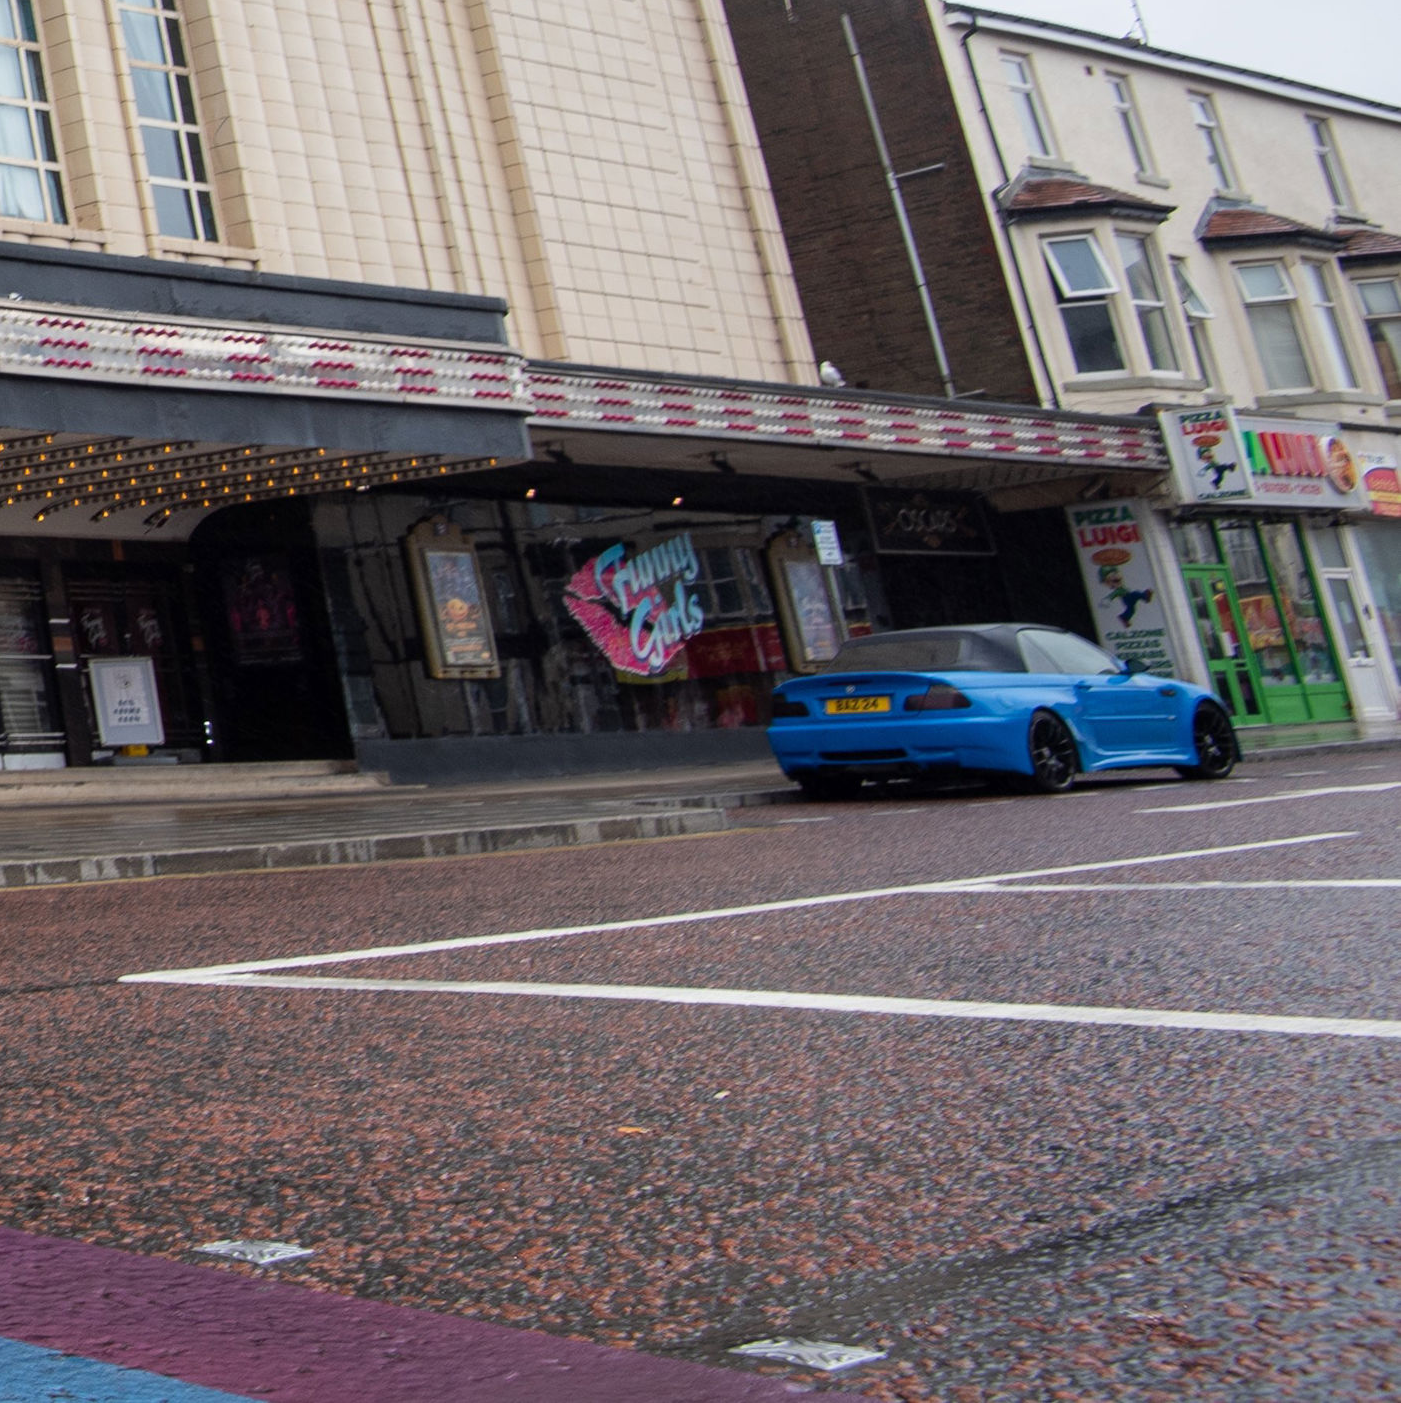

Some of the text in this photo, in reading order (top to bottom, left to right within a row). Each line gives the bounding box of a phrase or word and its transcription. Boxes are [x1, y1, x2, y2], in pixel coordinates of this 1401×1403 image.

[1179, 411, 1223, 424] PIZZA
[1181, 420, 1229, 436] LUIGI
[1074, 506, 1134, 527] PIZZA
[1077, 523, 1142, 547] LUIGI
[594, 532, 700, 620] Funny
[630, 580, 704, 671] Girls
[1106, 628, 1166, 641] CALZONE
[1115, 639, 1161, 650] PIZZAS
